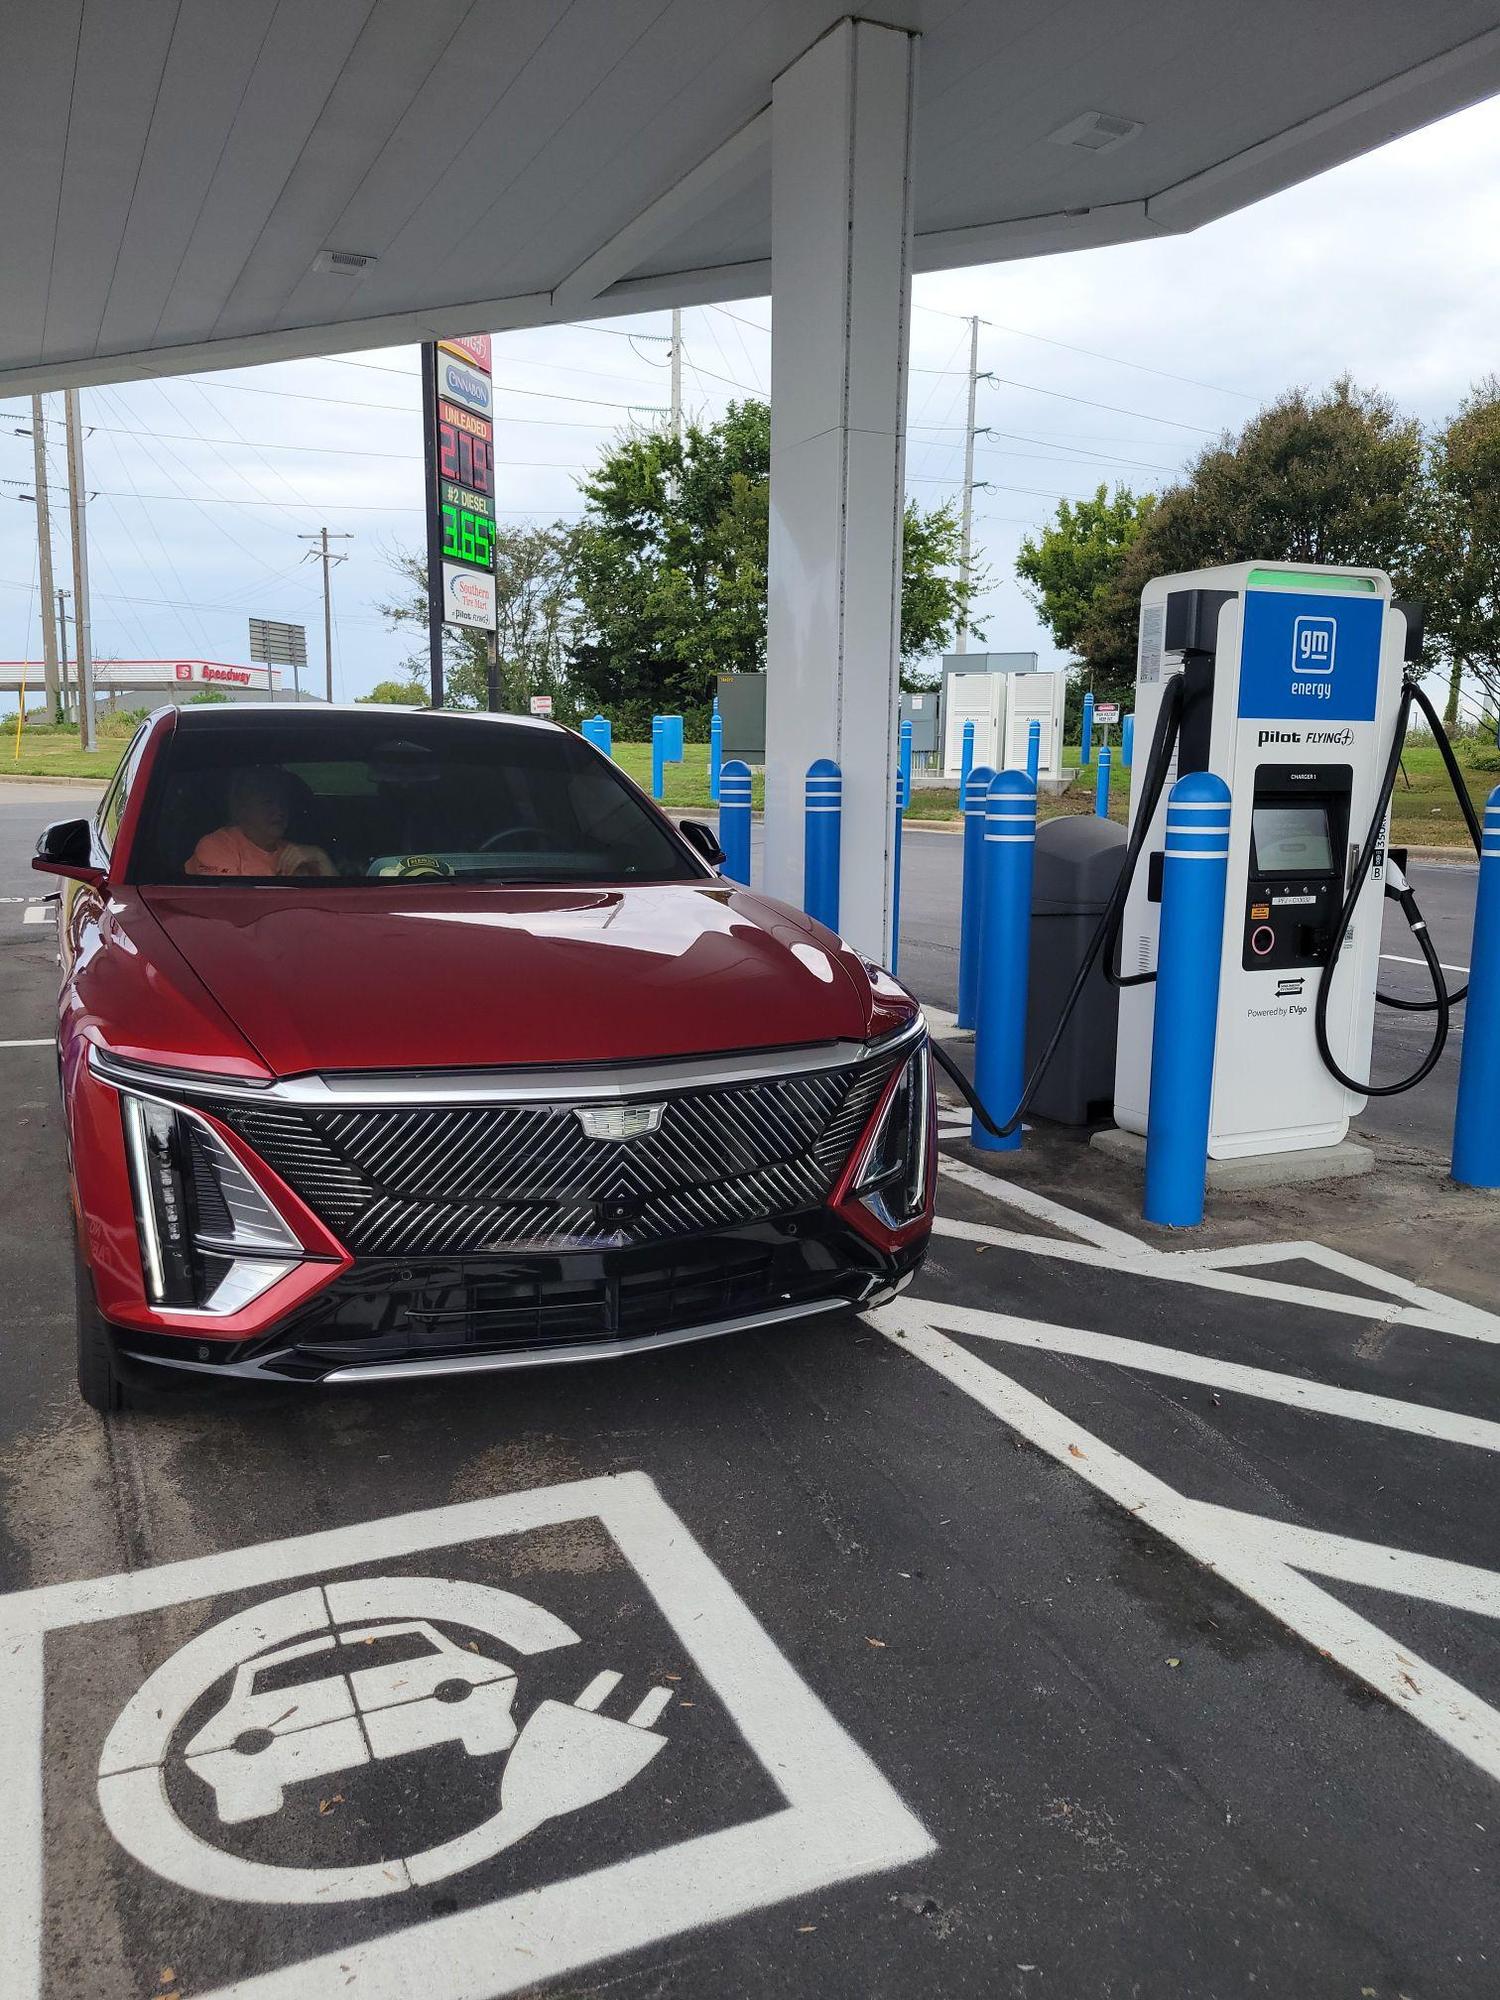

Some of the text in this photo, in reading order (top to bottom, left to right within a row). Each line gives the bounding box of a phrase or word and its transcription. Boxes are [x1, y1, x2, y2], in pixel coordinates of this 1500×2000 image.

[448, 370, 487, 403] CINNABON
[445, 405, 487, 438] UNLEADED
[447, 486, 489, 515] #2 DIESEL
[442, 504, 490, 567] 3.65
[459, 580, 489, 599] Southern
[1301, 630, 1329, 660] gm
[202, 665, 251, 685] Speedway
[1291, 682, 1331, 699] energy
[1373, 867, 1381, 878] B
[1247, 1005, 1308, 1018] Powered by EVgo
